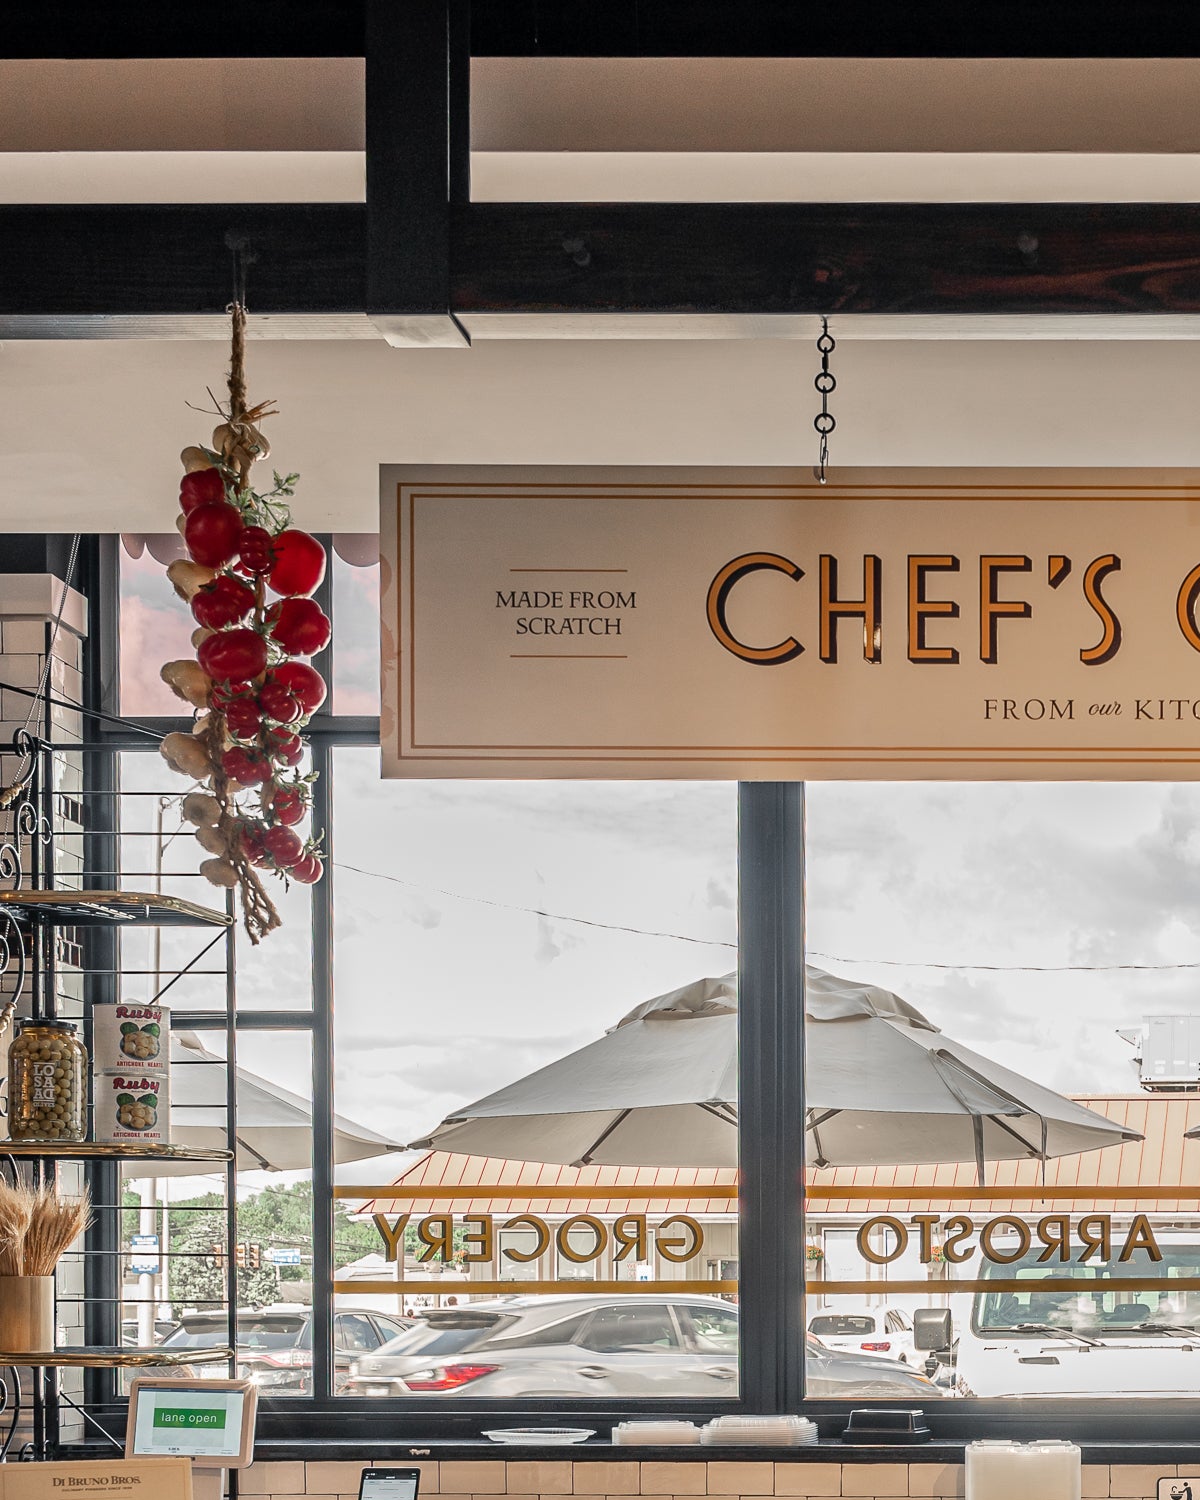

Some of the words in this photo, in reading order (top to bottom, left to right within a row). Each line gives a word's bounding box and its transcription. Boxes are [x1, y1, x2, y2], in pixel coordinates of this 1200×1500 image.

[495, 591, 564, 609] MADE
[569, 590, 637, 609] FROM
[516, 618, 622, 635] SCRATCH
[984, 699, 1076, 720] FROM
[1088, 701, 1122, 718] our
[116, 1006, 162, 1024] Ruby
[113, 1077, 160, 1094] Ruby
[161, 1412, 185, 1422] lane
[188, 1414, 217, 1424] open
